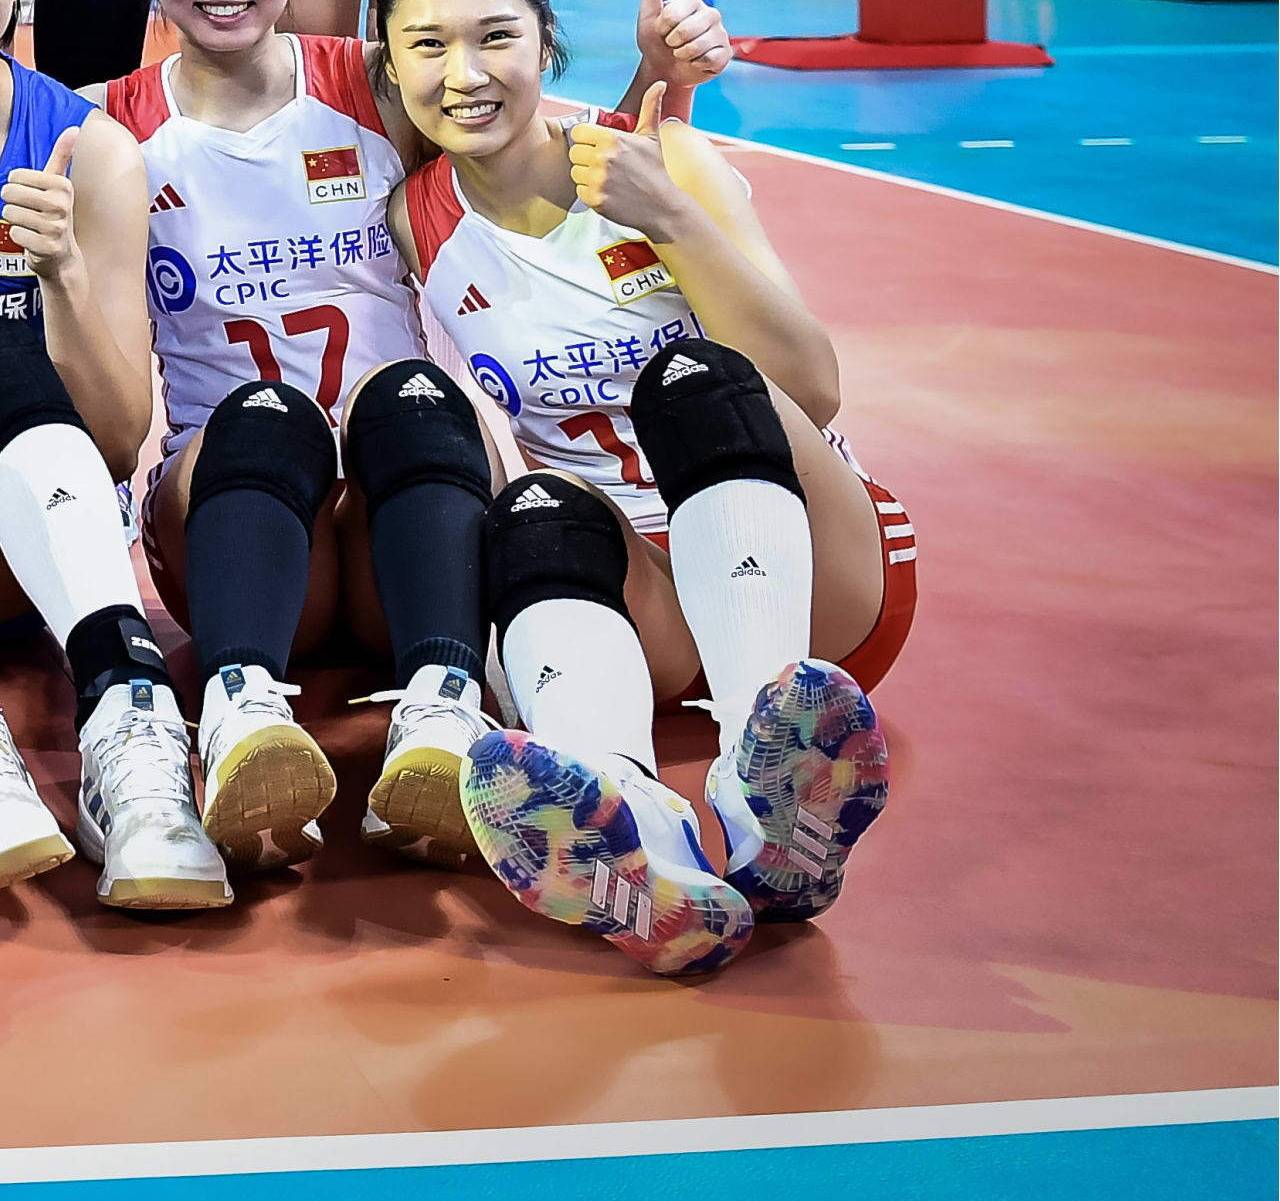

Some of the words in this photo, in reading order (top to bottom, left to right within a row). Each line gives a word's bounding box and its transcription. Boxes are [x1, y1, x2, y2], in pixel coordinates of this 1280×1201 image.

[315, 181, 360, 199] CHN
[207, 222, 392, 280] 太平洋保险
[215, 278, 291, 306] CPIC
[621, 268, 666, 297] CHN
[523, 311, 706, 387] 太平洋保
[223, 303, 350, 429] 17
[539, 377, 620, 408] CPIC
